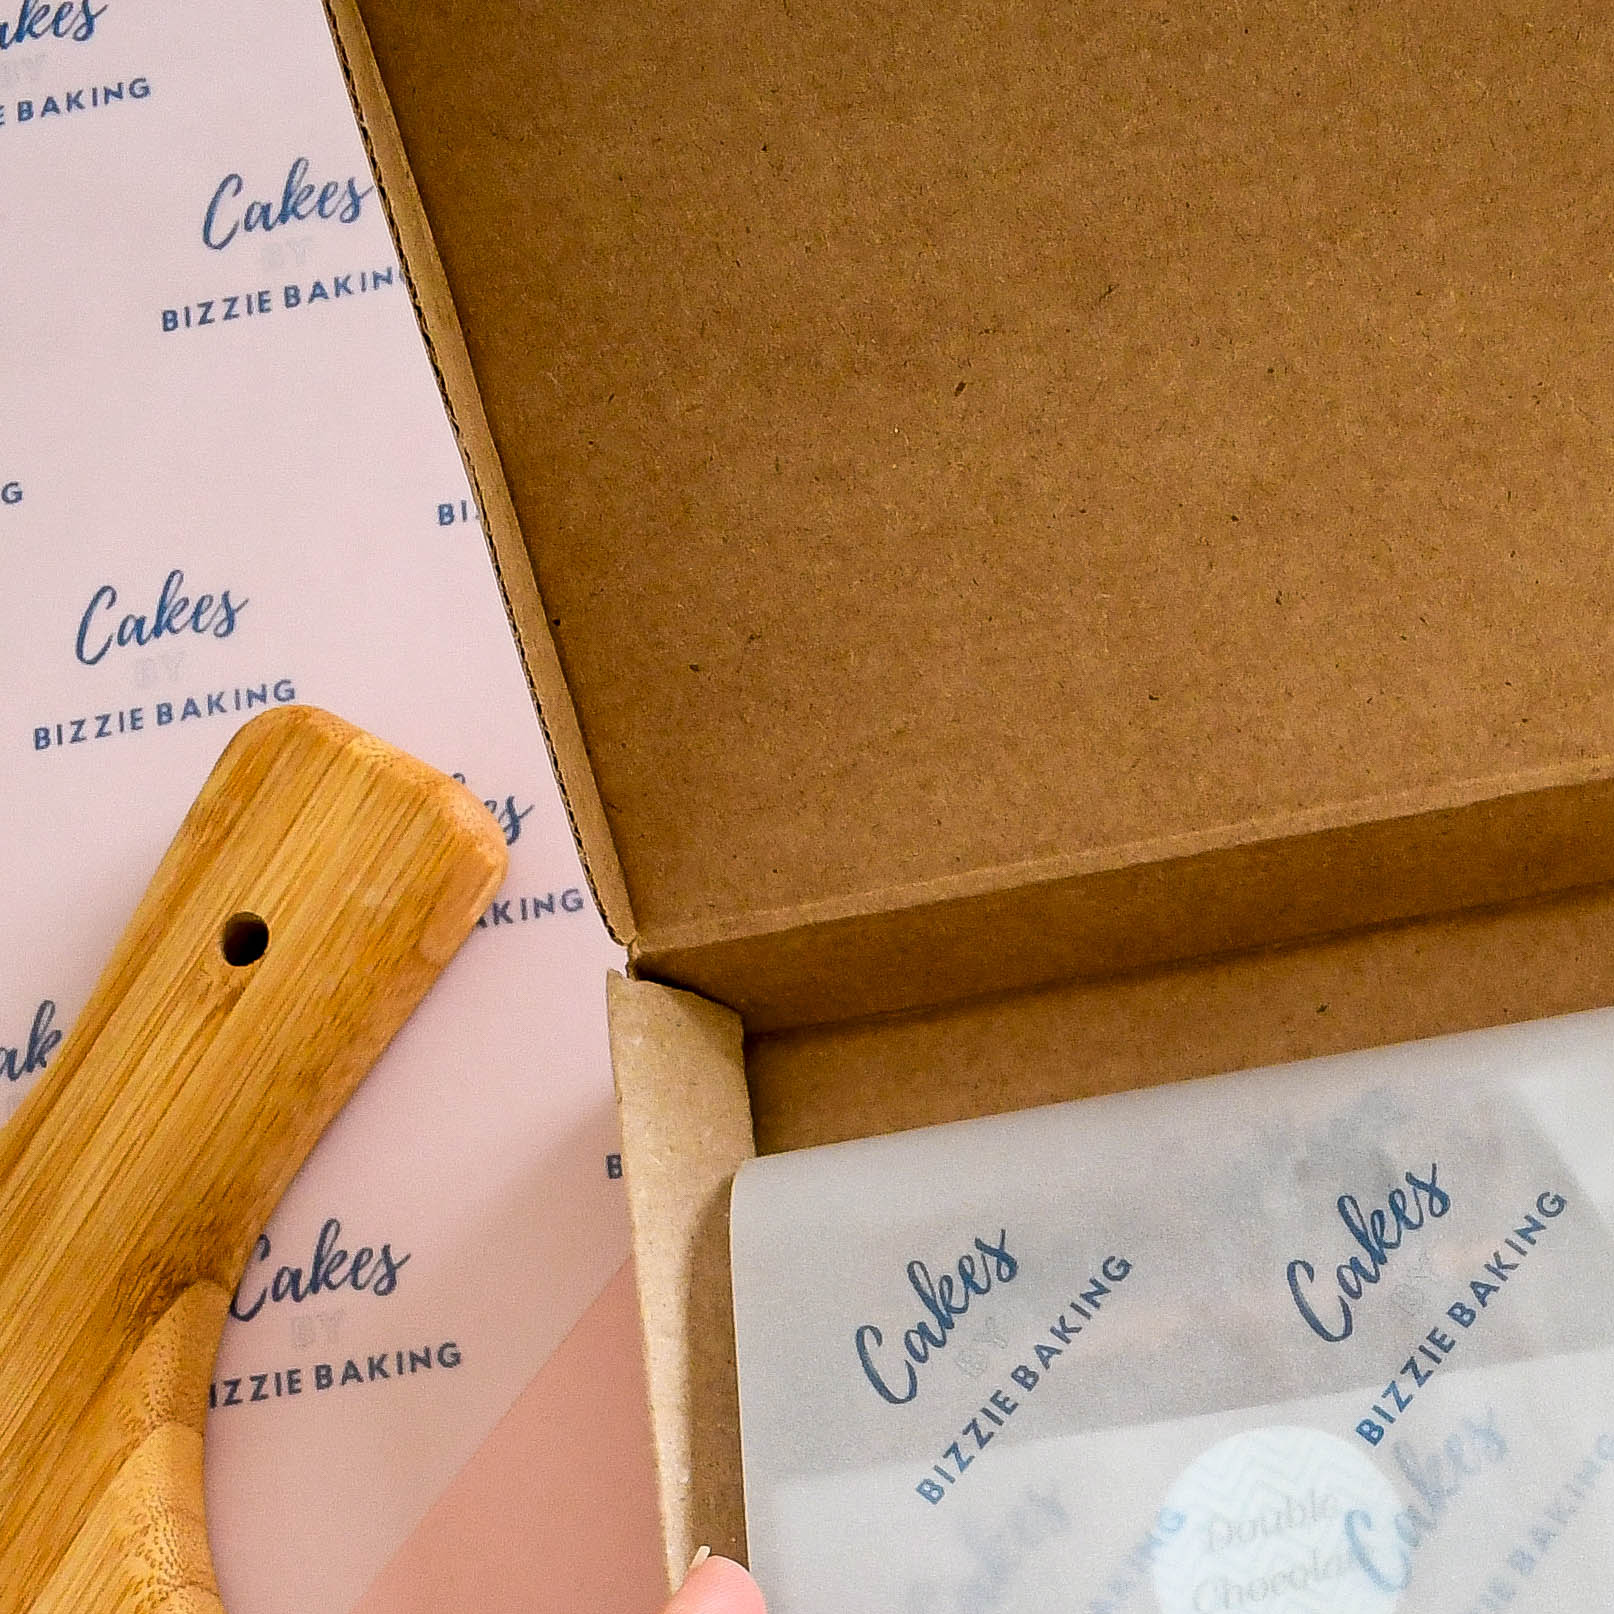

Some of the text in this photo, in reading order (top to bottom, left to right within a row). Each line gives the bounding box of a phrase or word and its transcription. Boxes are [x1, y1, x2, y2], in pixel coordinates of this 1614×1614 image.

[17, 77, 152, 122] BAKING
[202, 157, 377, 250] Cakes
[162, 266, 405, 332] BIZZIE BAKIN
[75, 569, 249, 666] Cakes
[33, 679, 296, 751] BIZZIE BAKING
[1287, 1163, 1451, 1342] Cakes
[855, 1229, 1019, 1405] Cakes
[1355, 1190, 1568, 1446] BIZZIE BAKING
[314, 1341, 462, 1391] BAKING
[916, 1389, 1019, 1504] BIZZIE
[1011, 1254, 1133, 1391] BAKING
